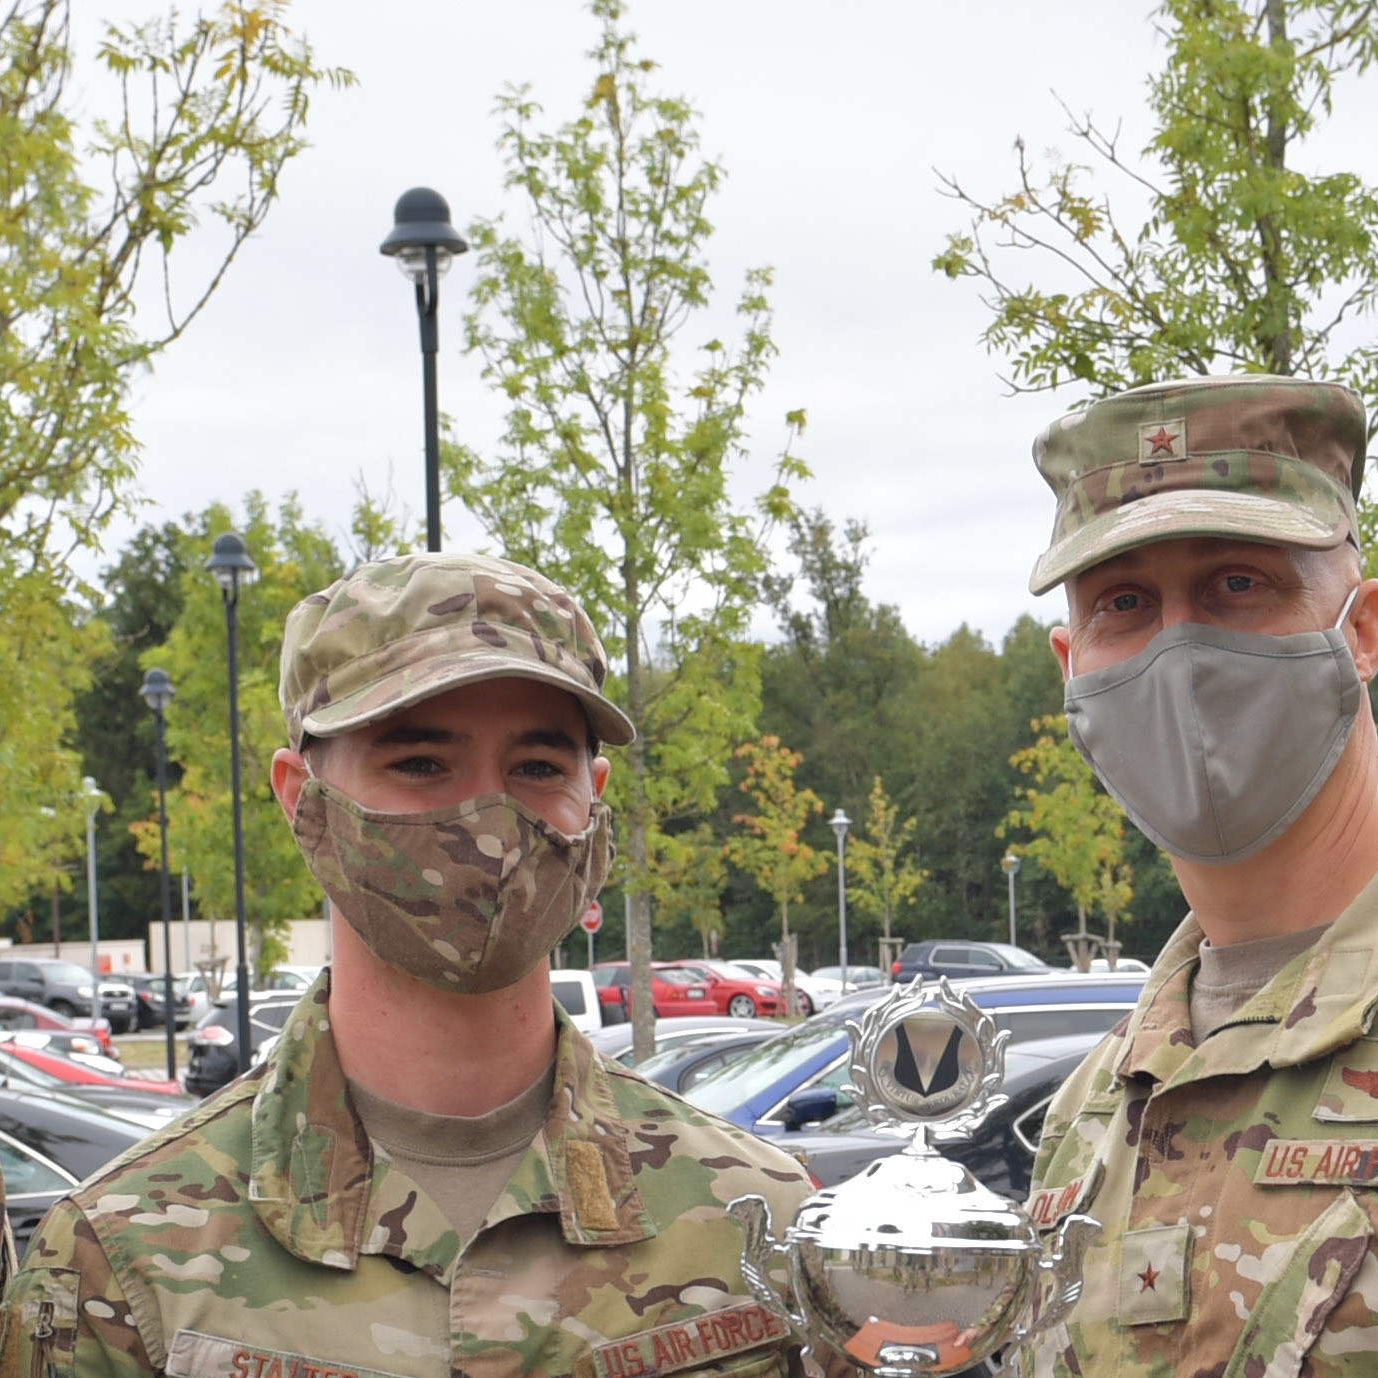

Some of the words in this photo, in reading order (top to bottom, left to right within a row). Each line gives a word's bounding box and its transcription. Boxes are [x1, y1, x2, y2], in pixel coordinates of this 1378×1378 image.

[1310, 1144, 1363, 1180] AIR
[650, 1327, 697, 1369] AIR
[695, 1303, 779, 1355] FORCE
